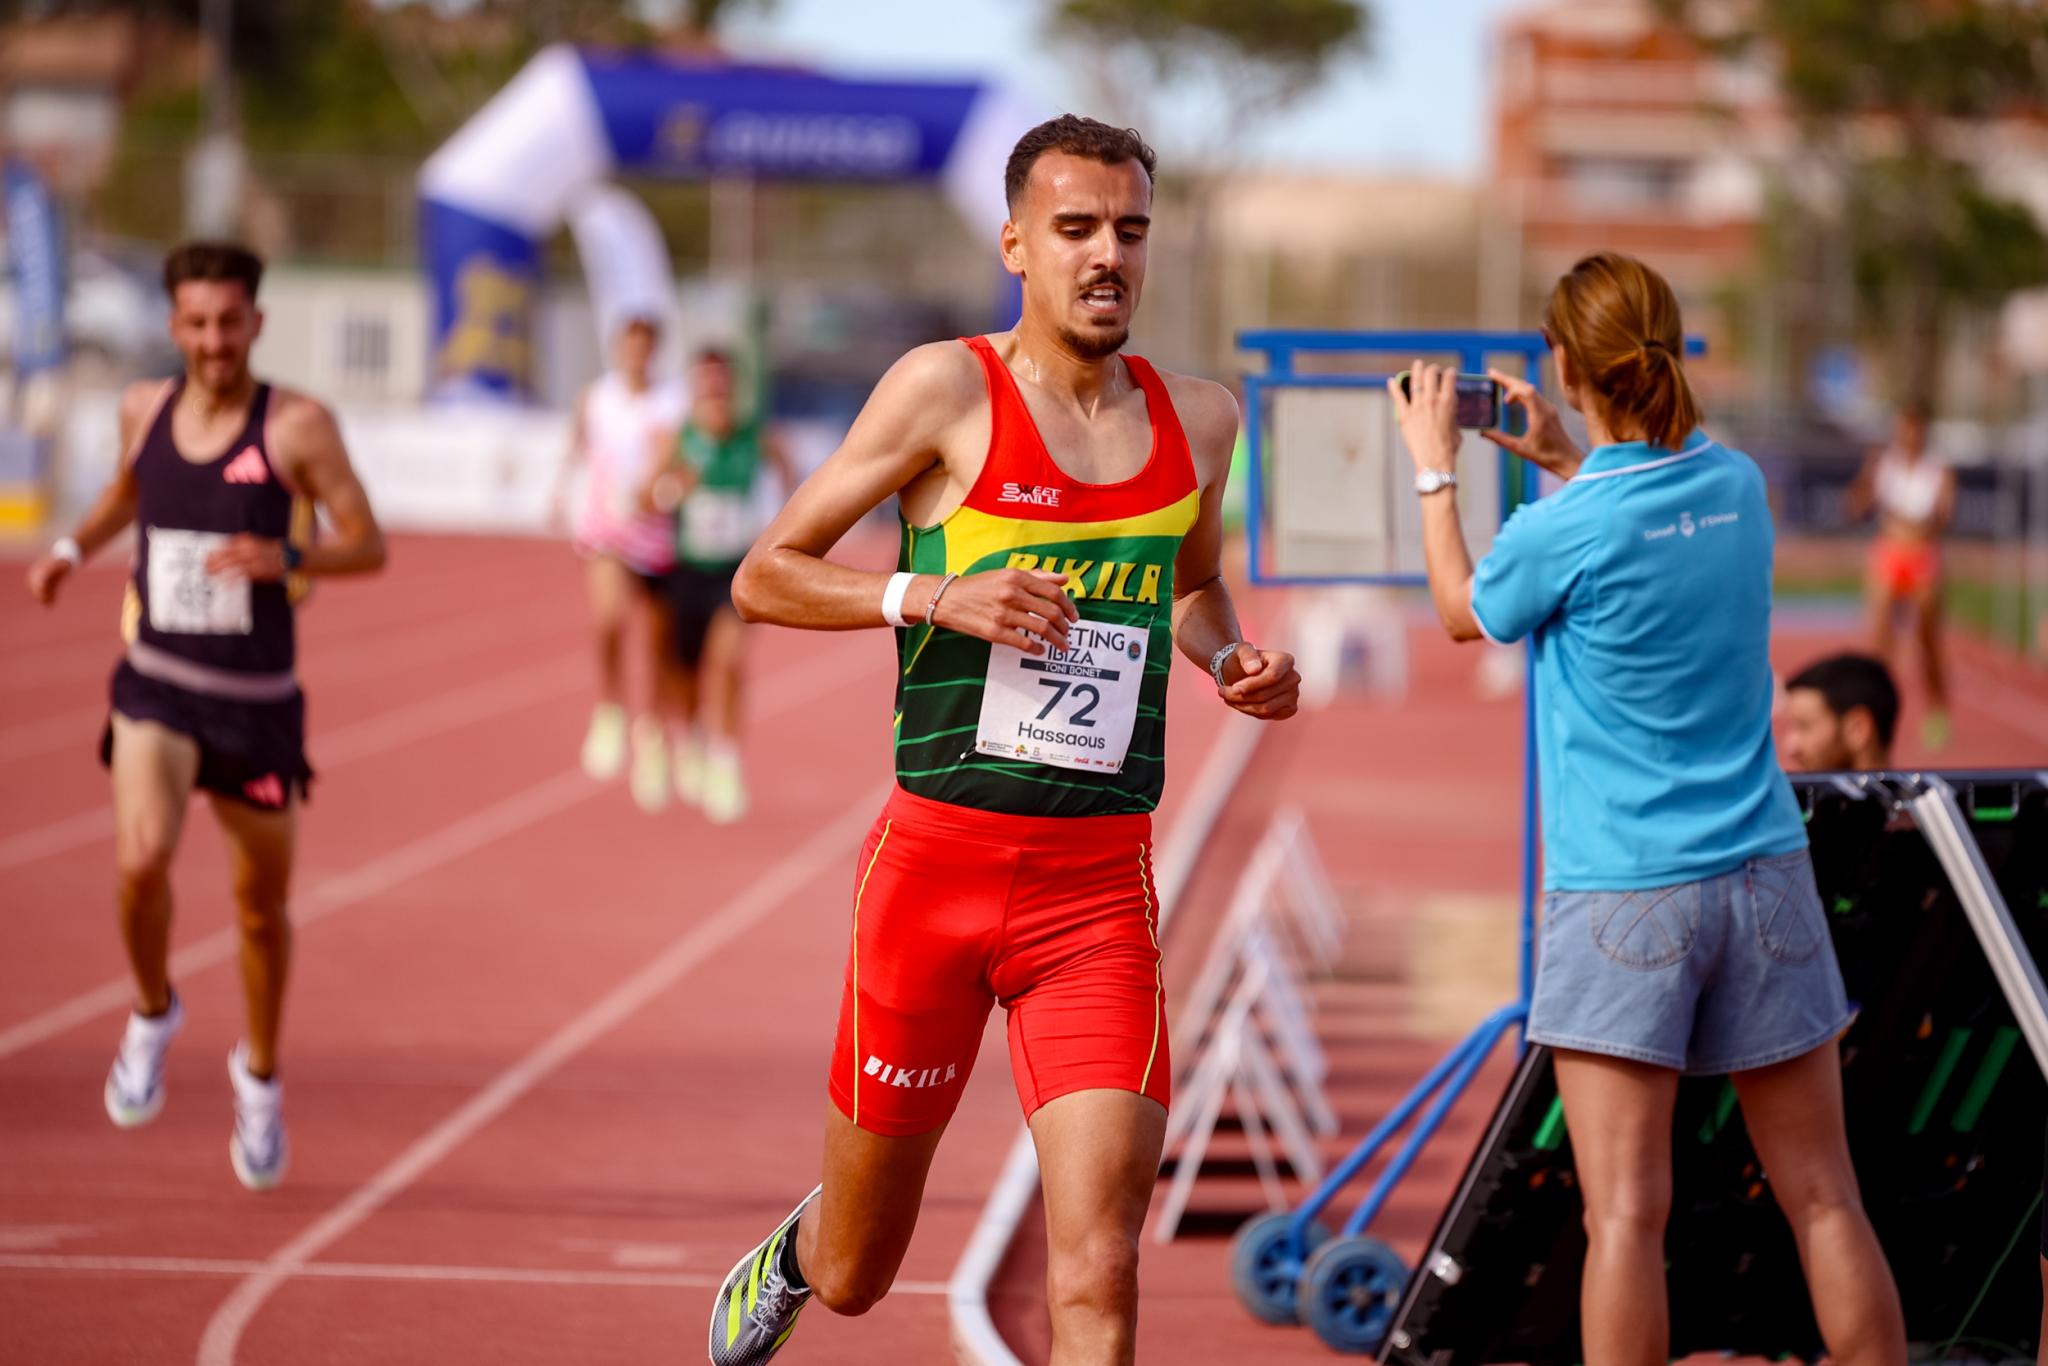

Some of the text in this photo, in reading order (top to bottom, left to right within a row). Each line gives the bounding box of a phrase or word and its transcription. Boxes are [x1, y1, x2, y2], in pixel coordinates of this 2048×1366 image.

[997, 490, 1060, 507] SMILE
[1003, 482, 1062, 497] SWEET
[1024, 627, 1125, 651] TING
[1047, 644, 1095, 666] IBIZA
[1044, 662, 1102, 678] TONI BONET
[1035, 678, 1100, 728] 72
[1018, 721, 1106, 750] Hassaous
[863, 1054, 956, 1089] BIKILA
